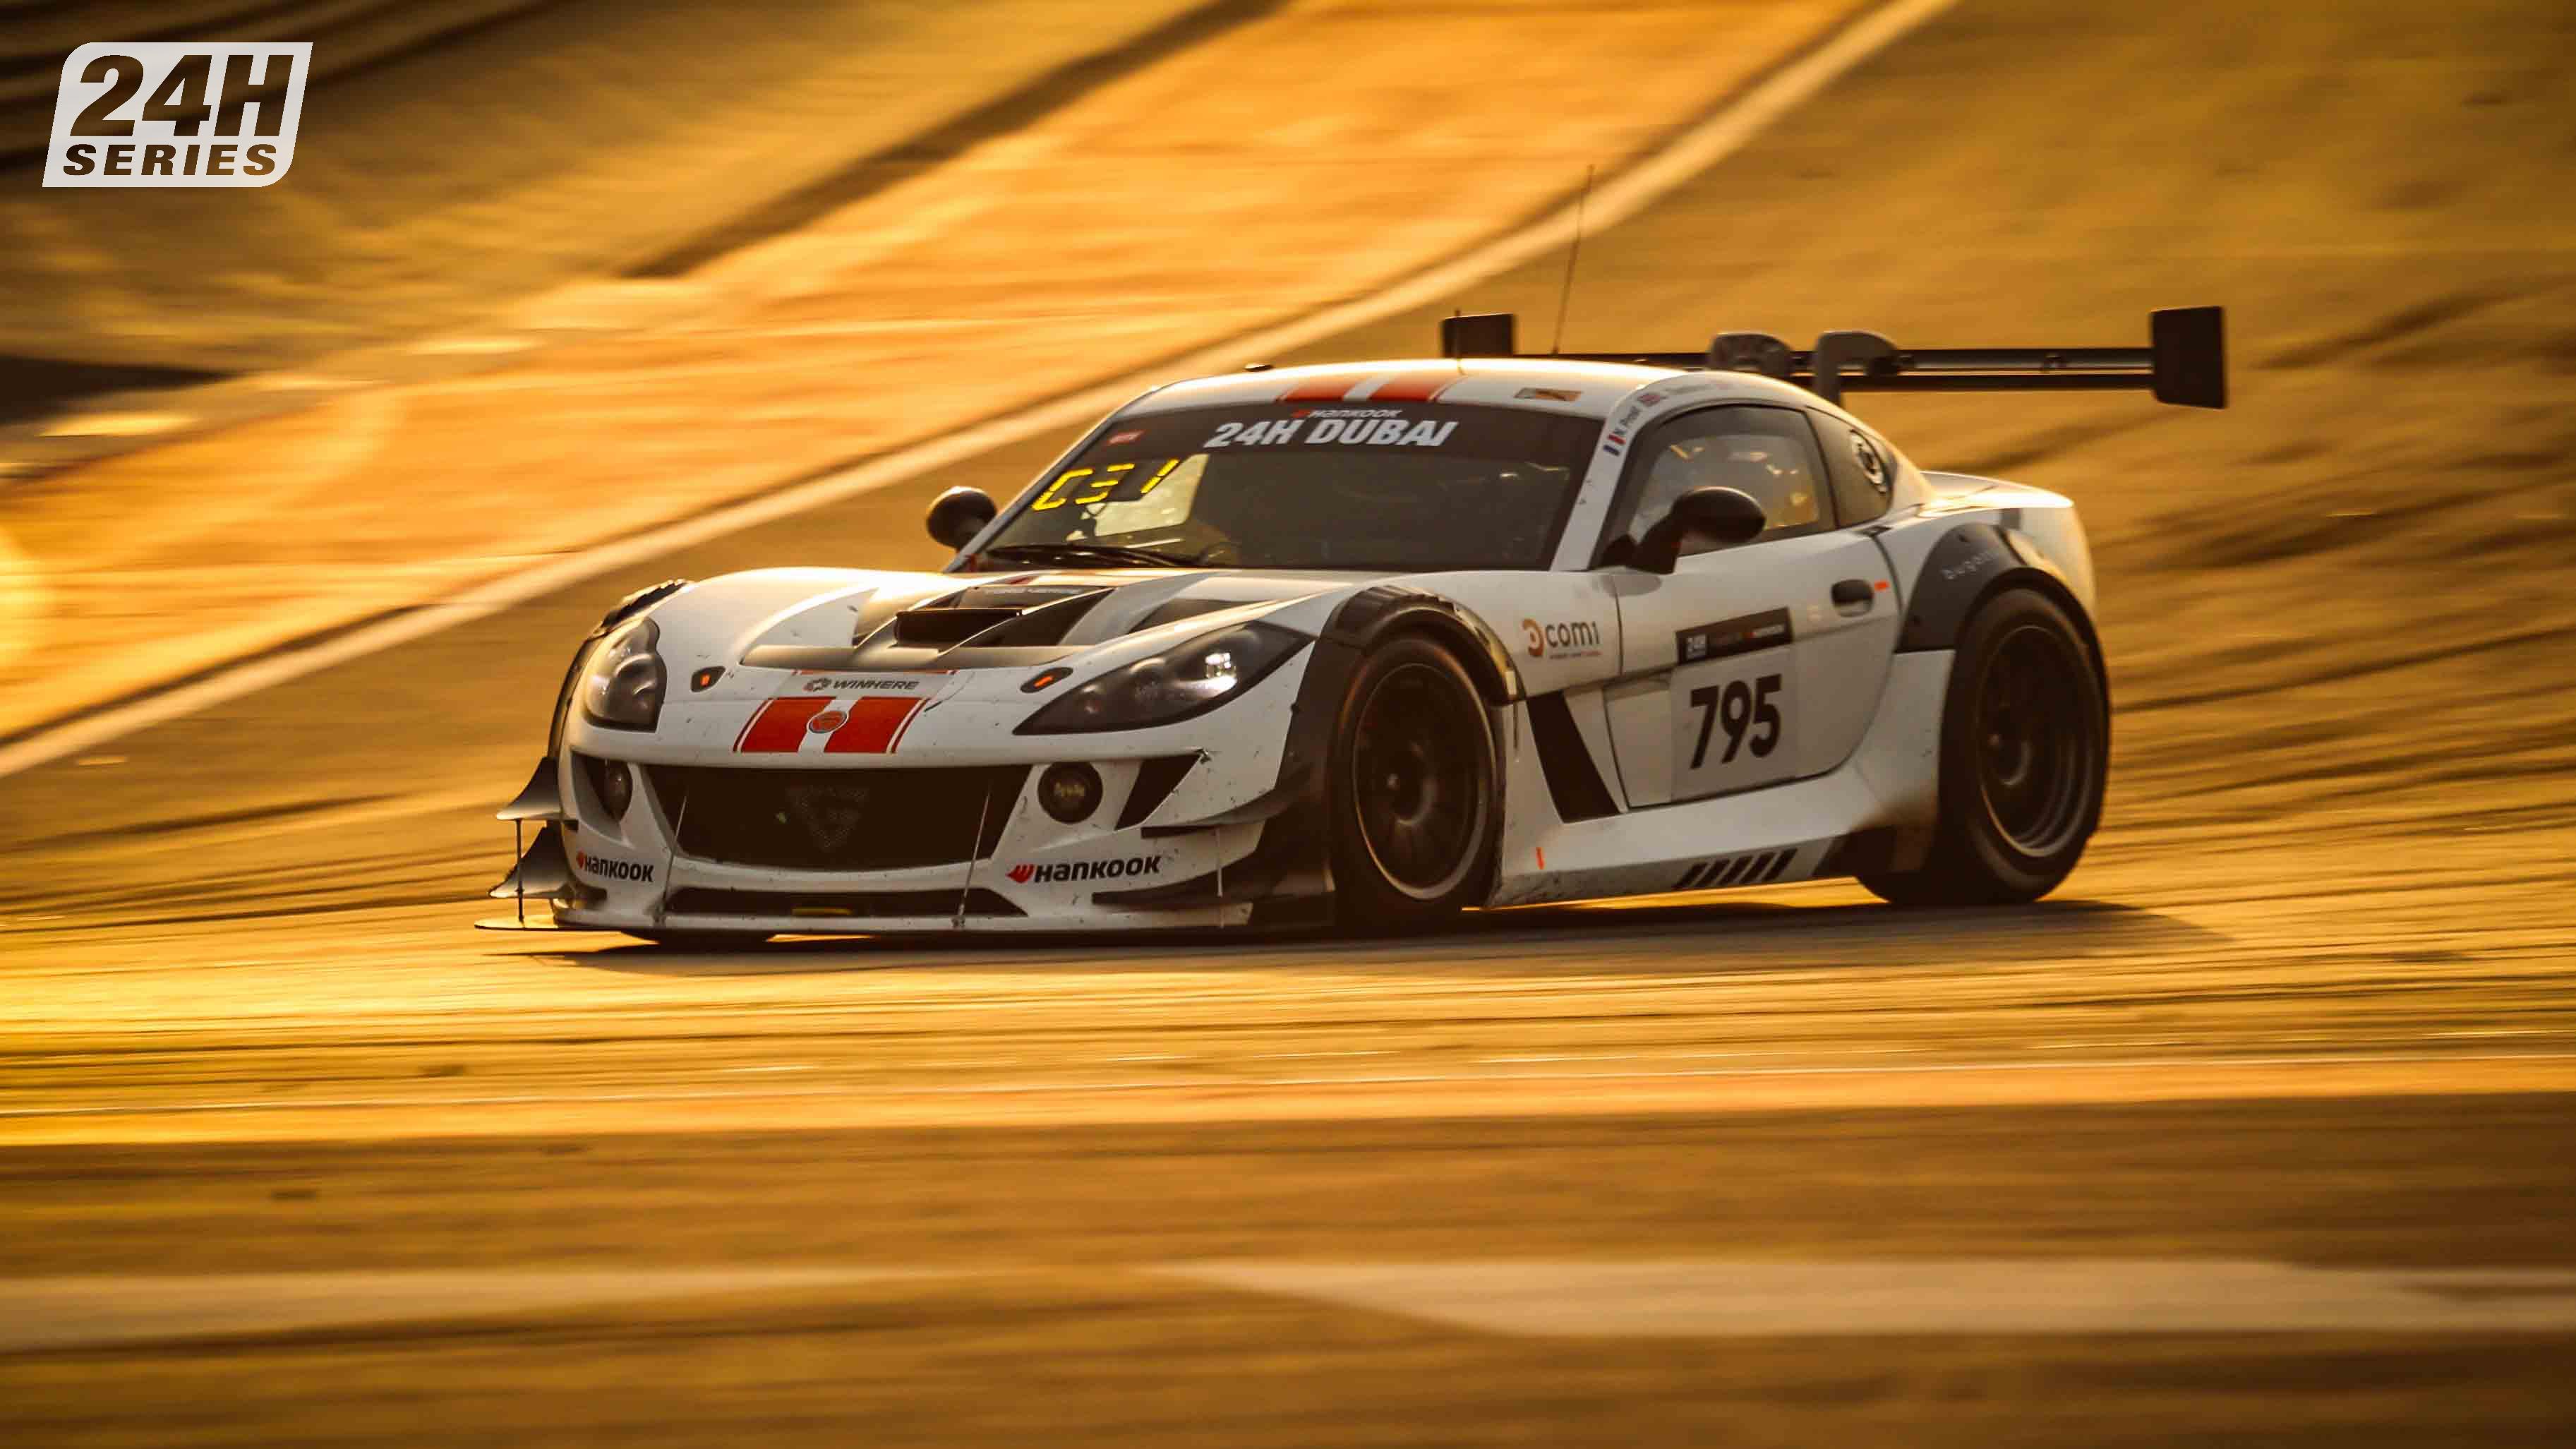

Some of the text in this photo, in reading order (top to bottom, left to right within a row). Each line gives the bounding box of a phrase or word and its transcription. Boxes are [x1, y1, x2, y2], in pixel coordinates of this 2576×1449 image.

[1203, 419, 1459, 448] 24H DUBAI
[833, 680, 920, 689] WINHERE
[1690, 673, 1782, 769] 795
